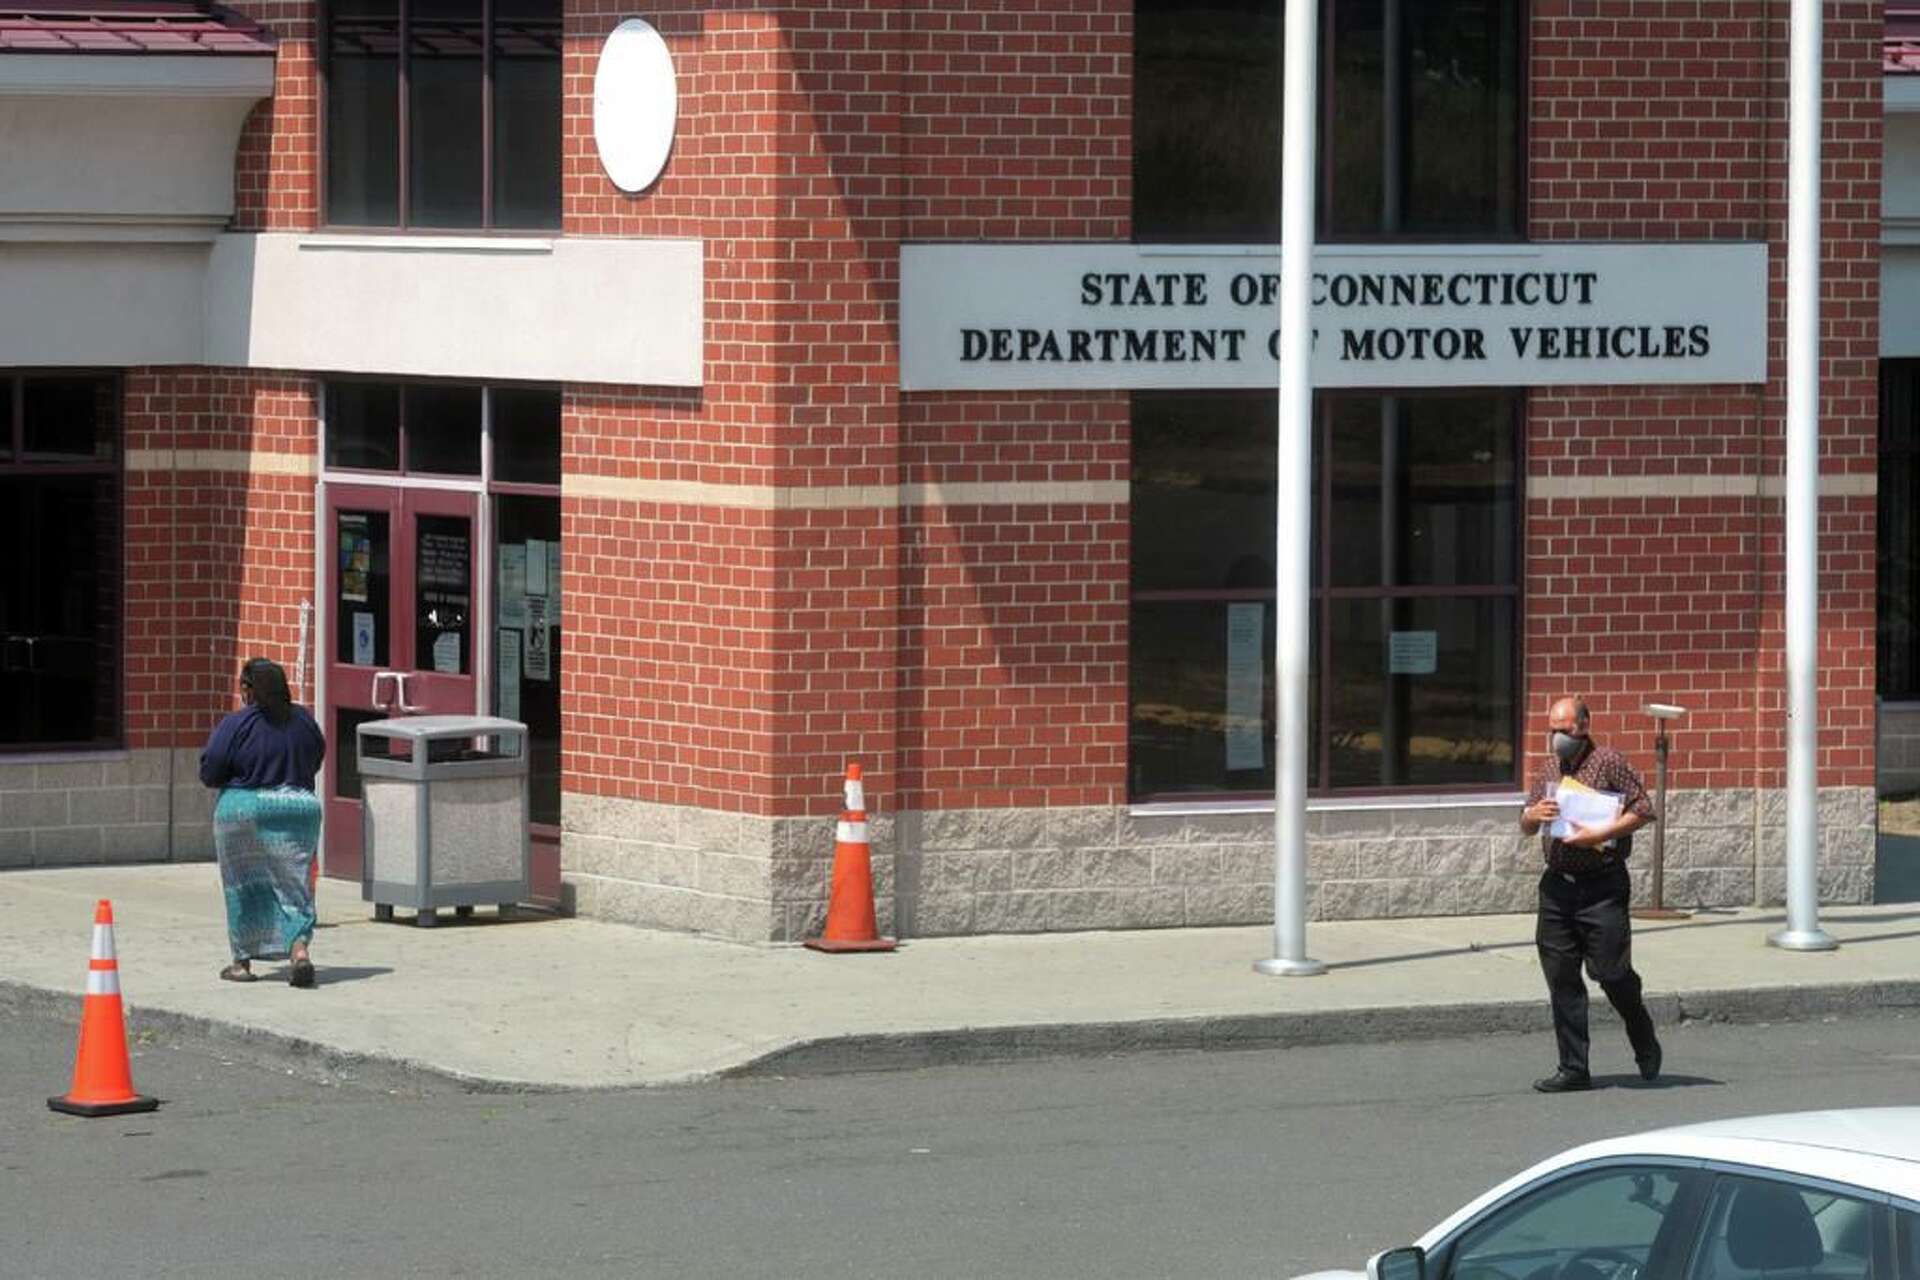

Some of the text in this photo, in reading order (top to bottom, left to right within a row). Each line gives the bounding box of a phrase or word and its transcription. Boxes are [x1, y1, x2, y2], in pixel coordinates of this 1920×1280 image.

[1081, 272, 1208, 307] STATE
[1229, 272, 1280, 307] OF
[959, 328, 1246, 363] DEPARTMENT
[1340, 327, 1487, 361] MOTOR
[1509, 324, 1711, 360] VEHICLES
